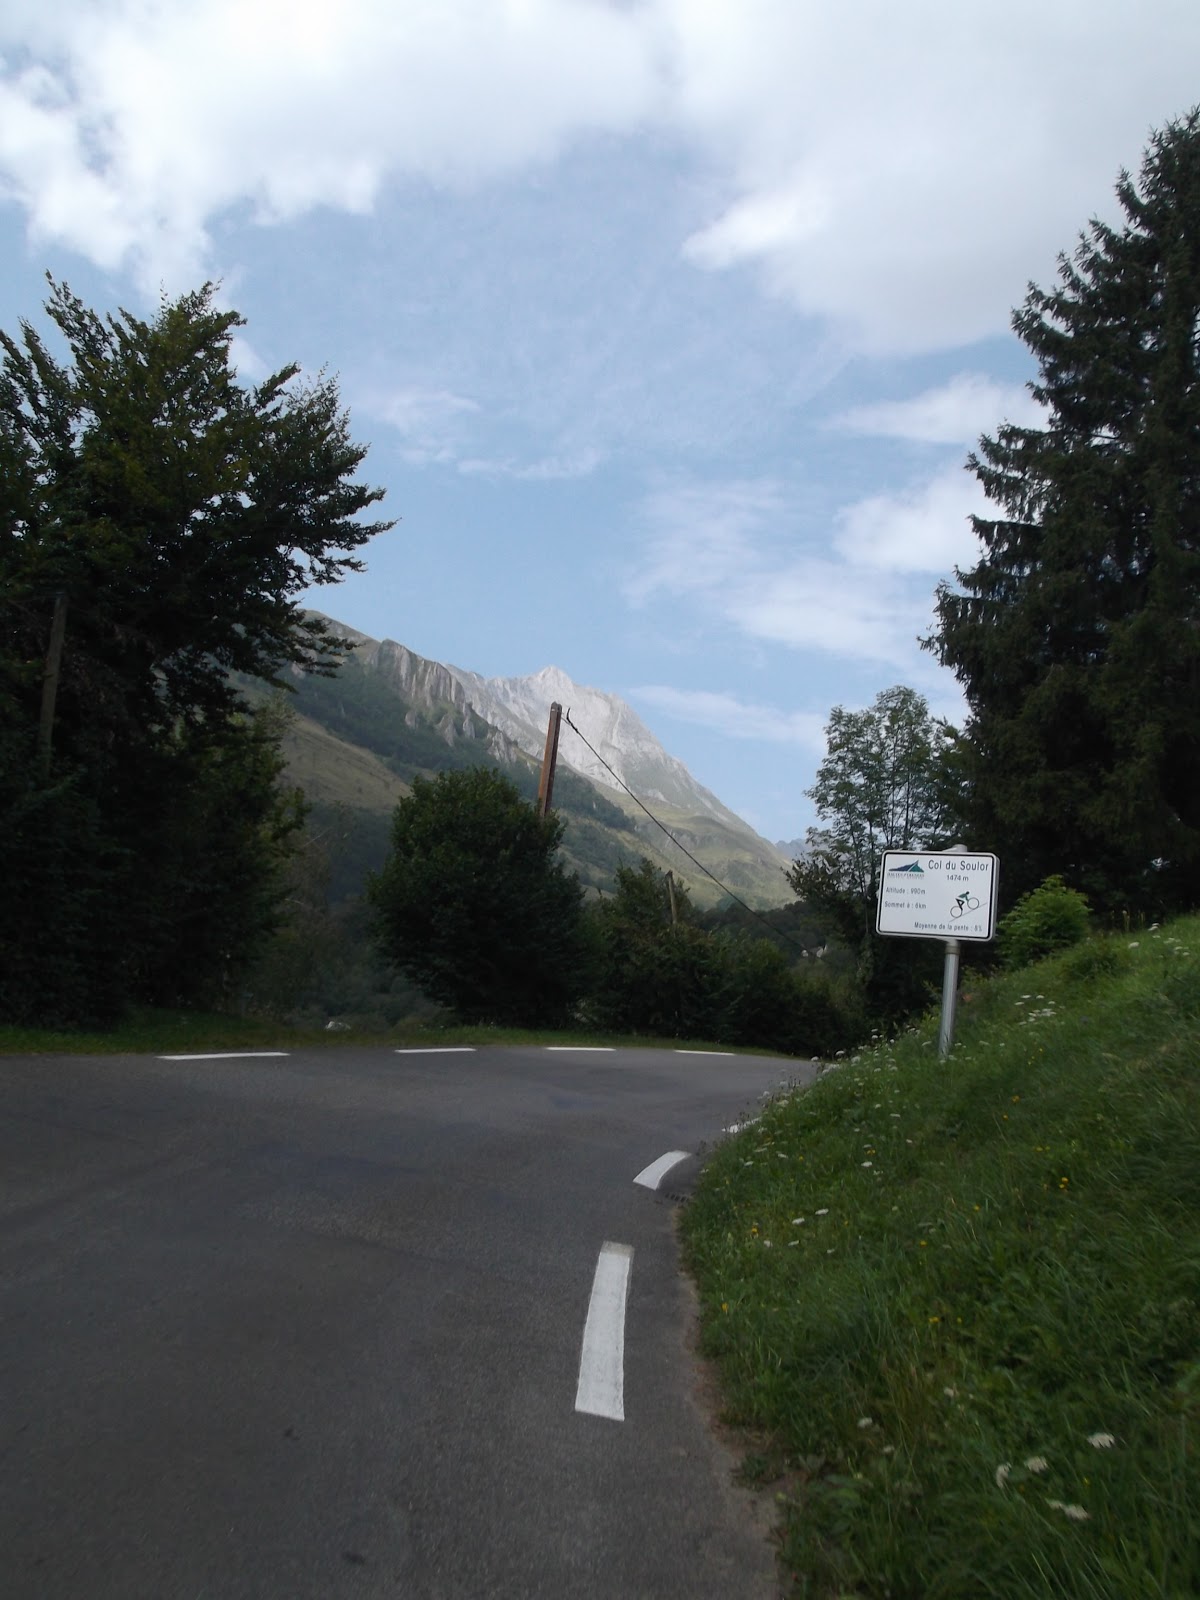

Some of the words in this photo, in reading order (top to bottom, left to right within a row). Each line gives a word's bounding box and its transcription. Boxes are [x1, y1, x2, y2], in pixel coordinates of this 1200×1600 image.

[928, 859, 942, 870] Col
[945, 860, 957, 870] du
[960, 860, 989, 871] Soulor
[946, 874, 962, 882] 1474
[885, 886, 905, 894] Altitude
[884, 900, 905, 908] Sommet
